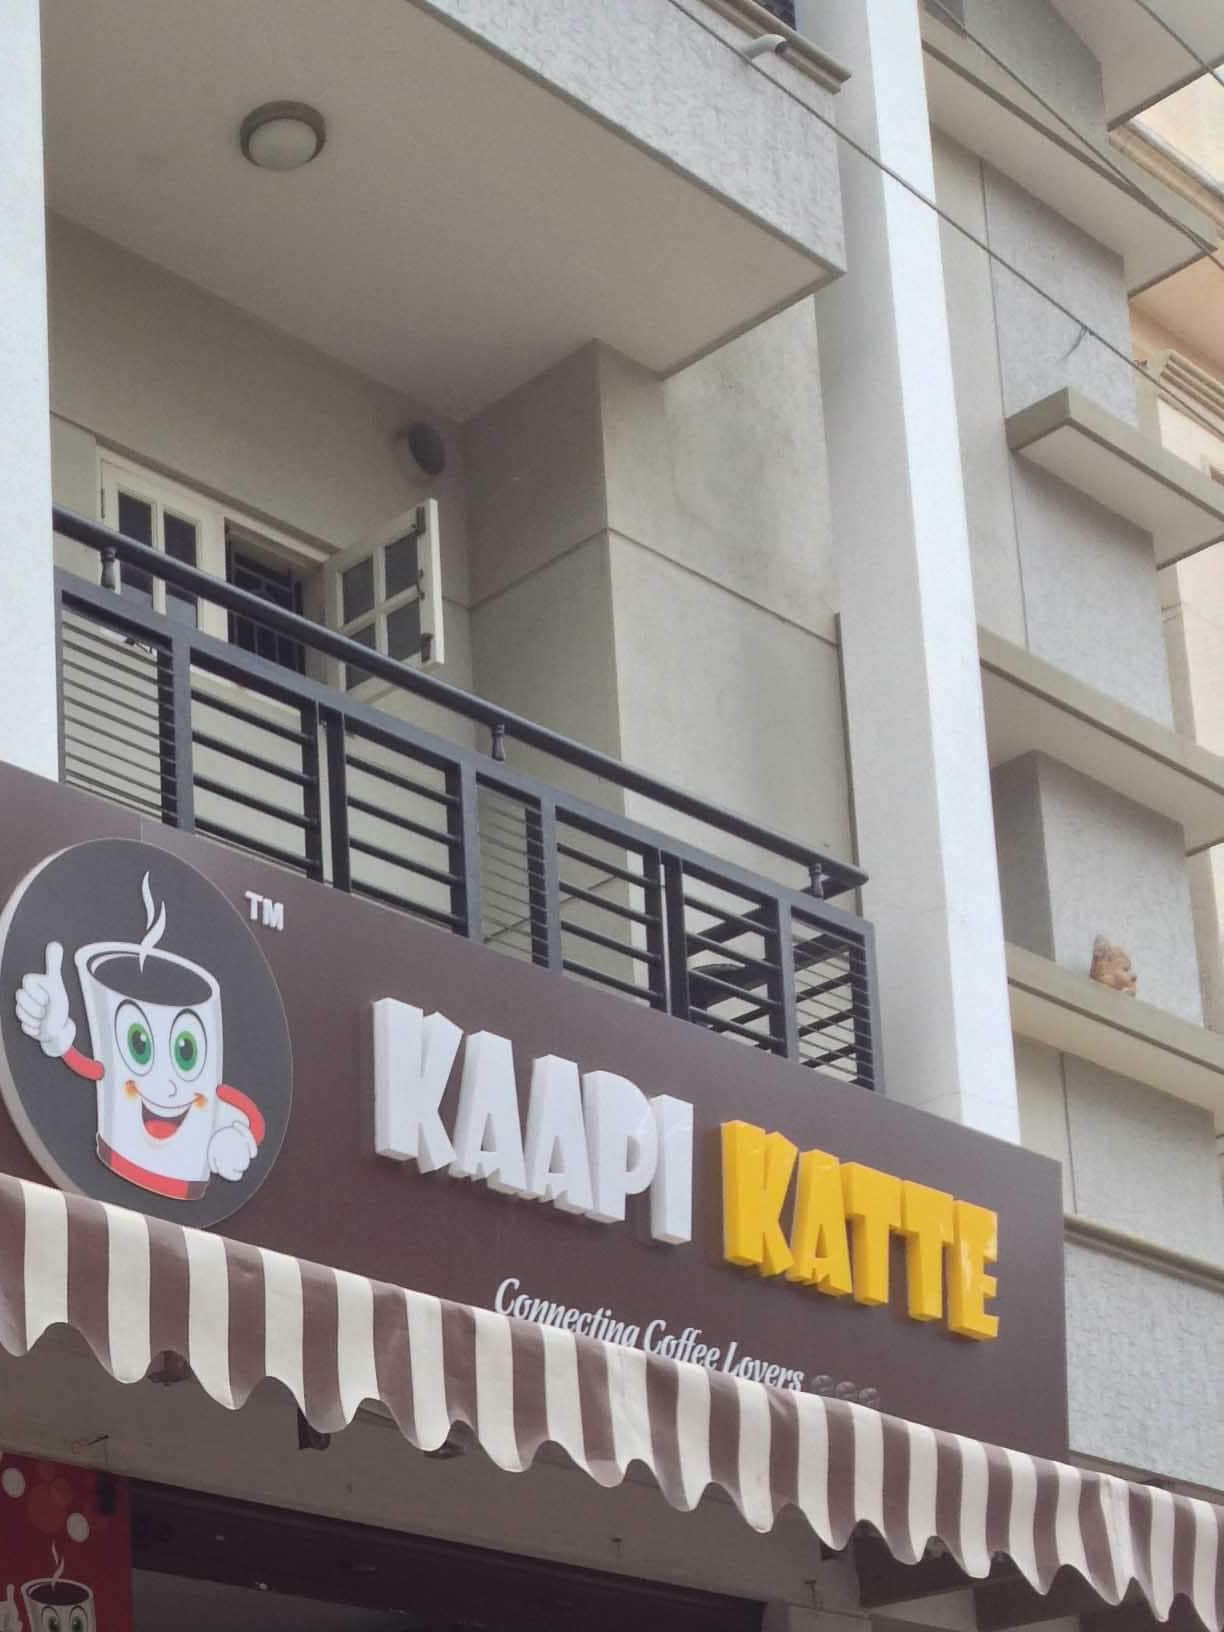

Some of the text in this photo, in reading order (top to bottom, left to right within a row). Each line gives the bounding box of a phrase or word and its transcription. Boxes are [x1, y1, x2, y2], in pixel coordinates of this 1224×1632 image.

[245, 890, 284, 931] TM
[373, 997, 1000, 1341] KAAPI KATTE
[495, 1278, 805, 1393] Connecting Coffee Lovers
